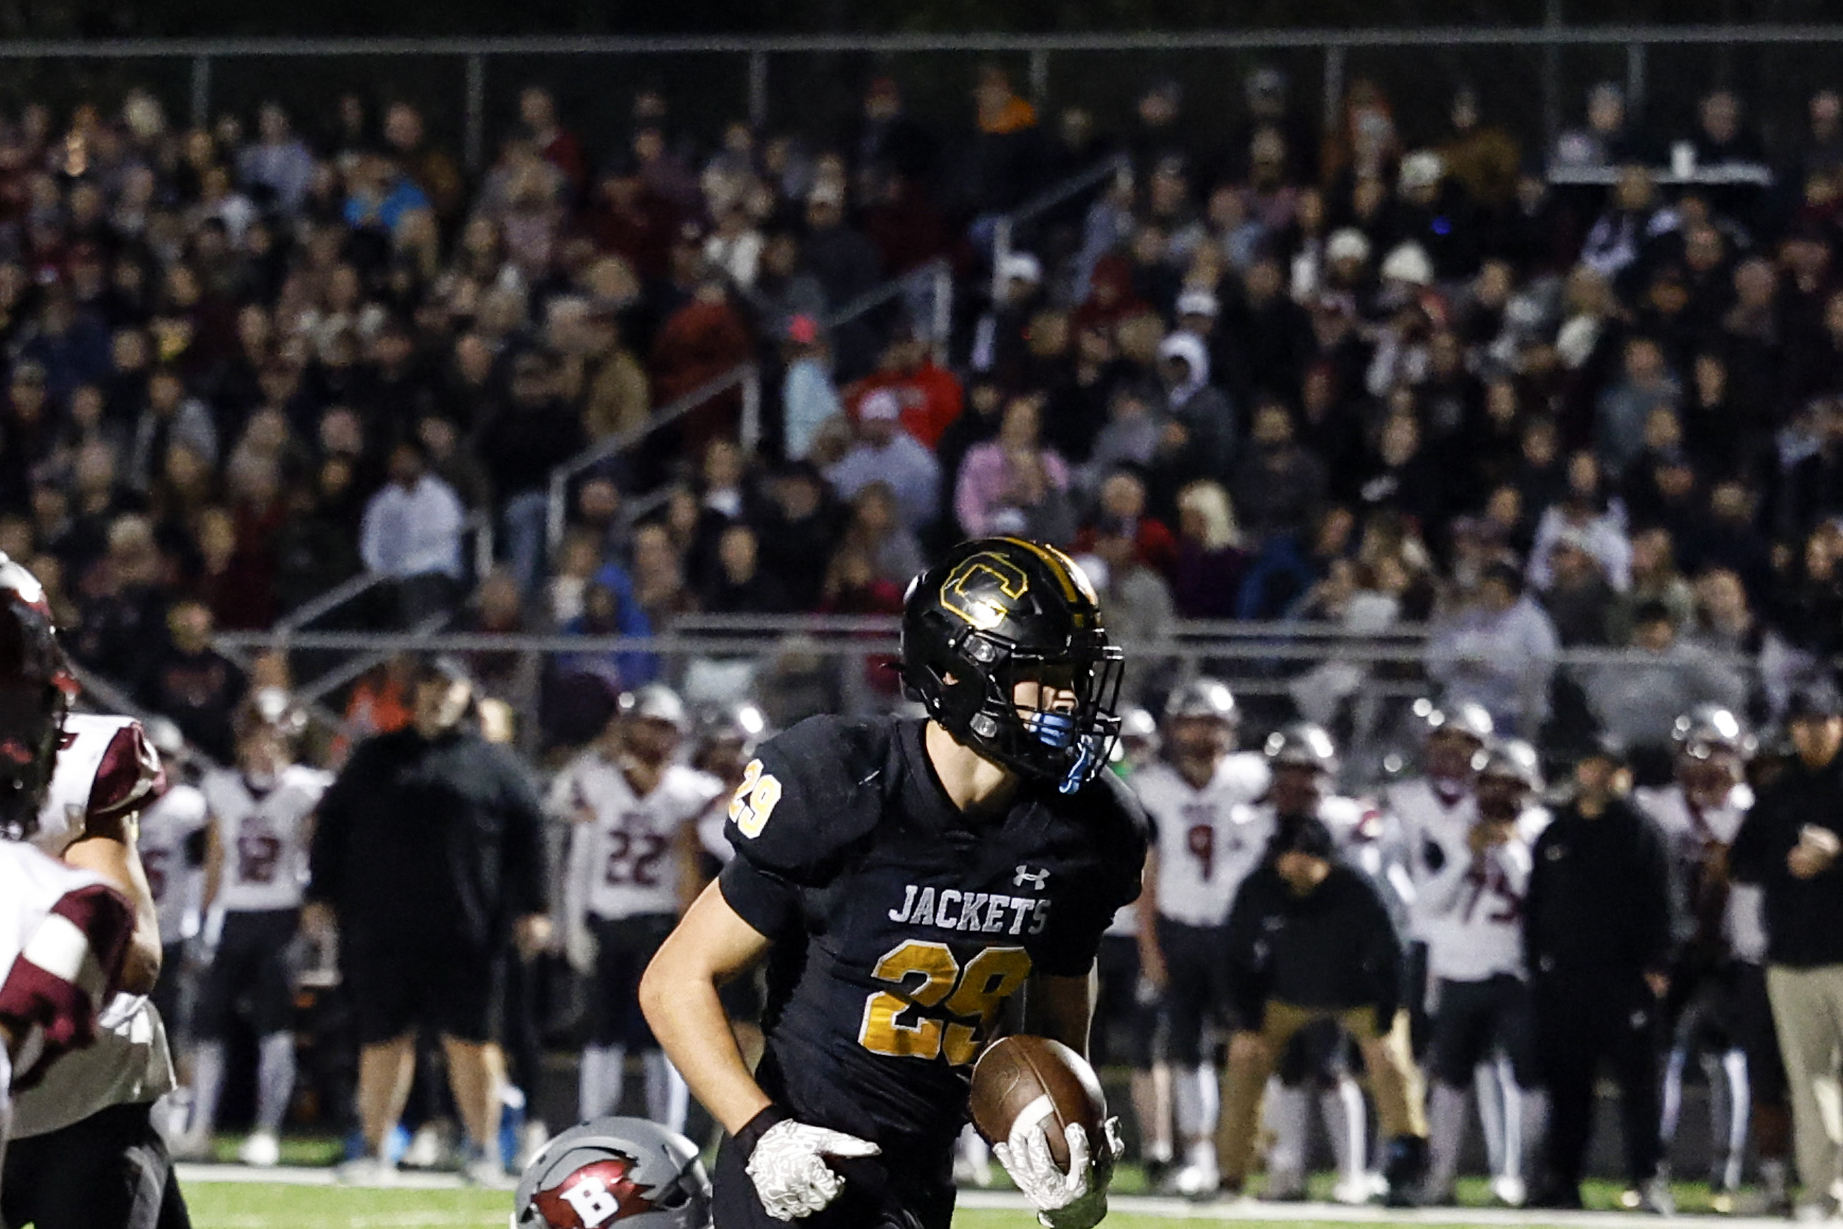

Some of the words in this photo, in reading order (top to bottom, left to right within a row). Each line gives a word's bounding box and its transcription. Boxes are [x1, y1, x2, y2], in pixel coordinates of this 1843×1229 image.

[728, 758, 782, 839] 29
[605, 830, 668, 887] 22
[889, 883, 1053, 936] JACKETS
[858, 938, 1033, 1067] 29
[559, 1176, 620, 1229] B
